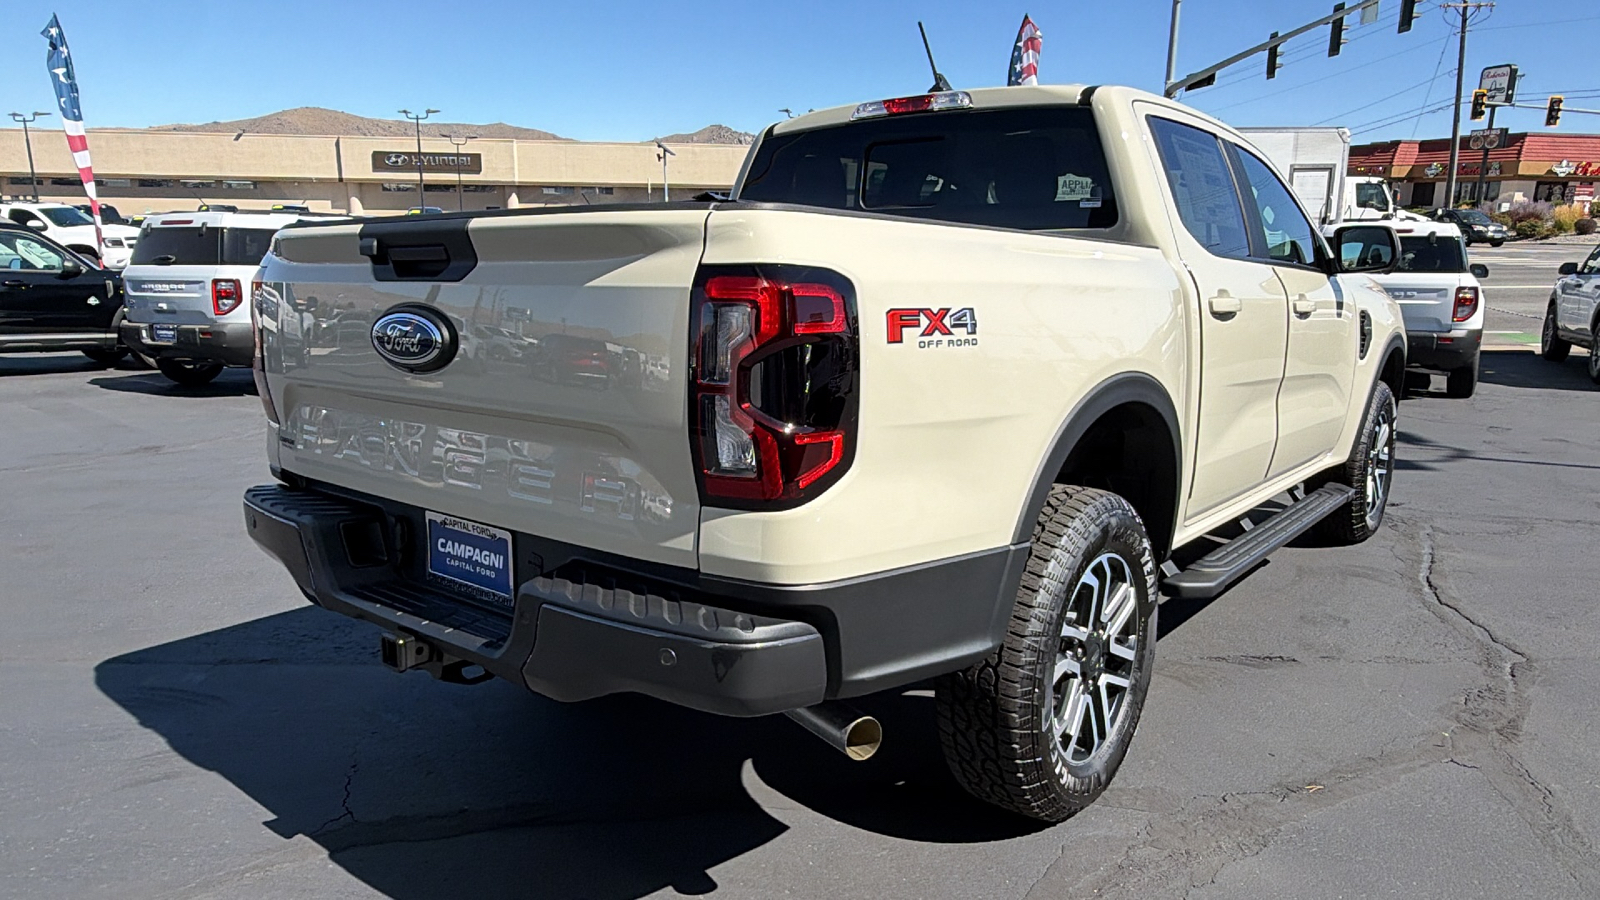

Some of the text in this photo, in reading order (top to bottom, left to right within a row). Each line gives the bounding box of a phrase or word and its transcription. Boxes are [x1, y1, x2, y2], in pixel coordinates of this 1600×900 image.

[411, 155, 471, 166] HYUNDAI
[386, 323, 421, 353] Ford
[886, 307, 977, 344] FX4
[918, 338, 978, 349] OFF ROAD
[295, 419, 640, 521] RANGER
[443, 517, 492, 537] CAPITAL FORD
[437, 538, 504, 569] CAMPAGNI
[446, 557, 496, 578] CAPITAL FORD
